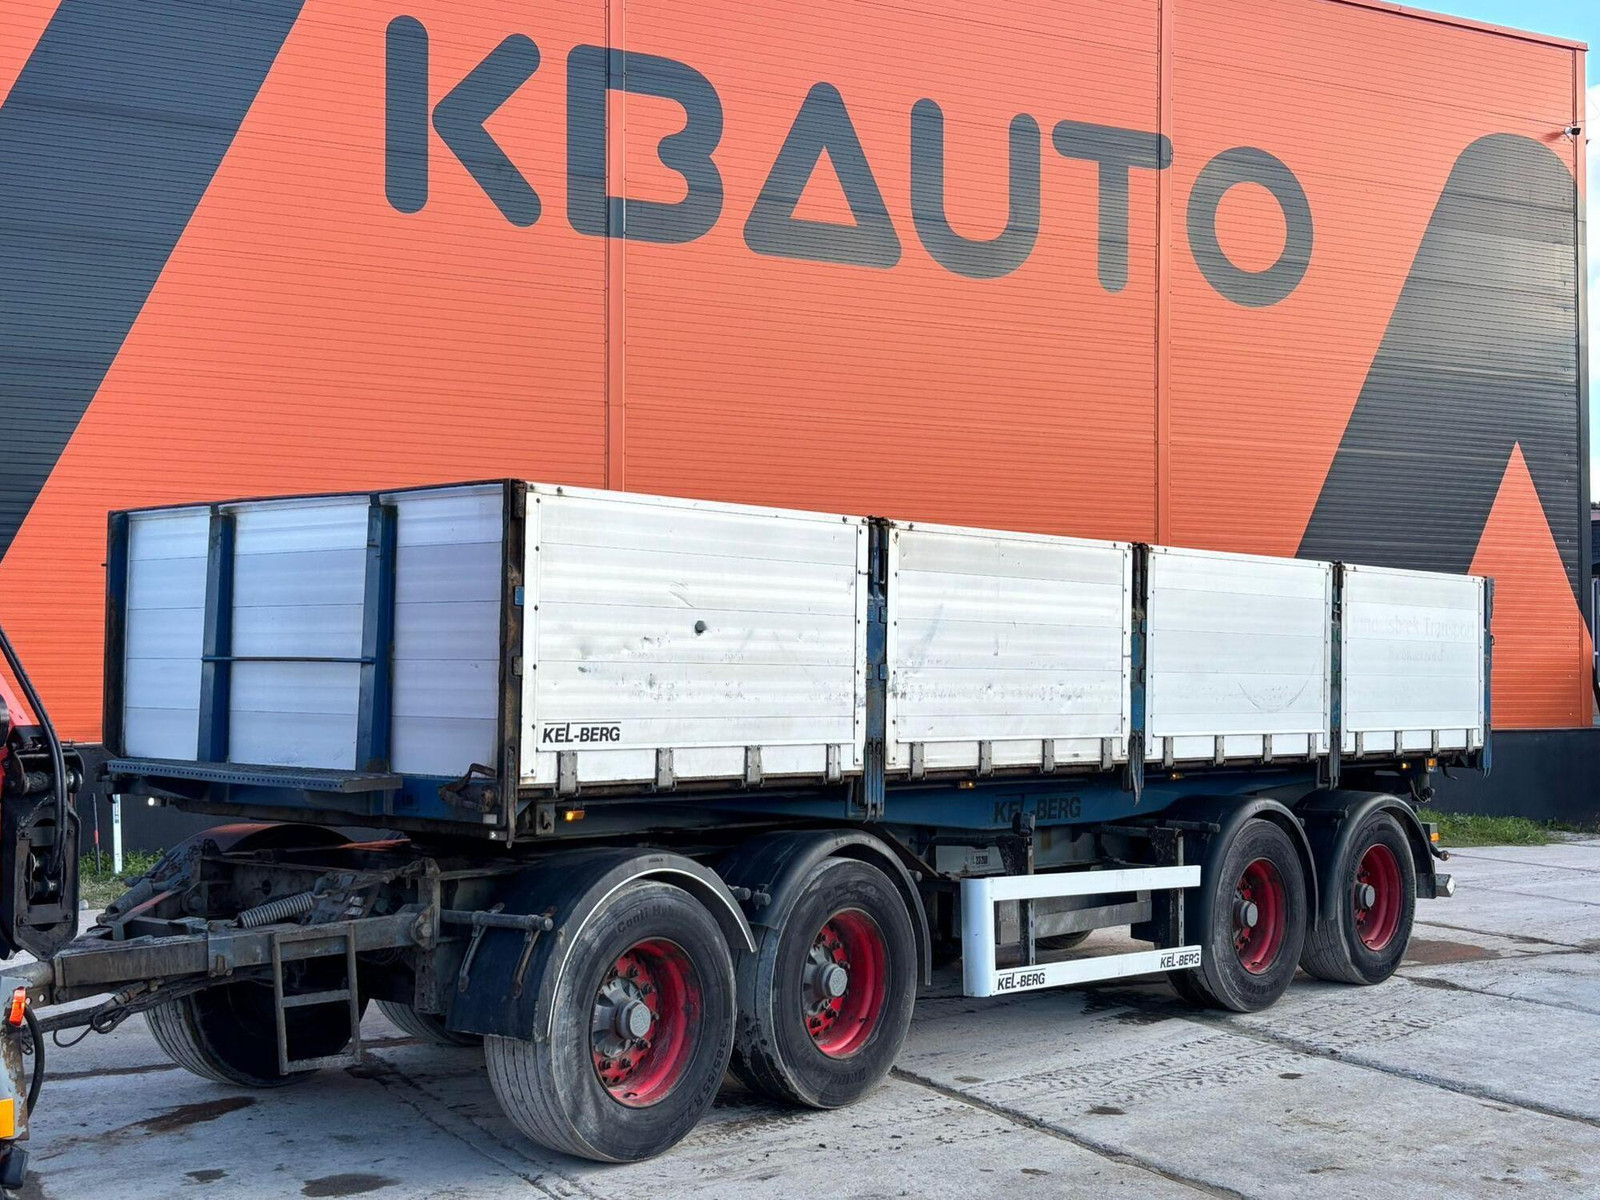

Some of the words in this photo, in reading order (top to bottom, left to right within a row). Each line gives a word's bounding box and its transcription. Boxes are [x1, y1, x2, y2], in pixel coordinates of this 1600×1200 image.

[385, 15, 1313, 308] KBAUTO
[542, 722, 621, 743] KEL-BERG
[616, 906, 649, 934] Conti
[1160, 953, 1200, 968] KEL-BERG
[997, 972, 1046, 990] KEL-BERG
[701, 1038, 728, 1095] 385/55
